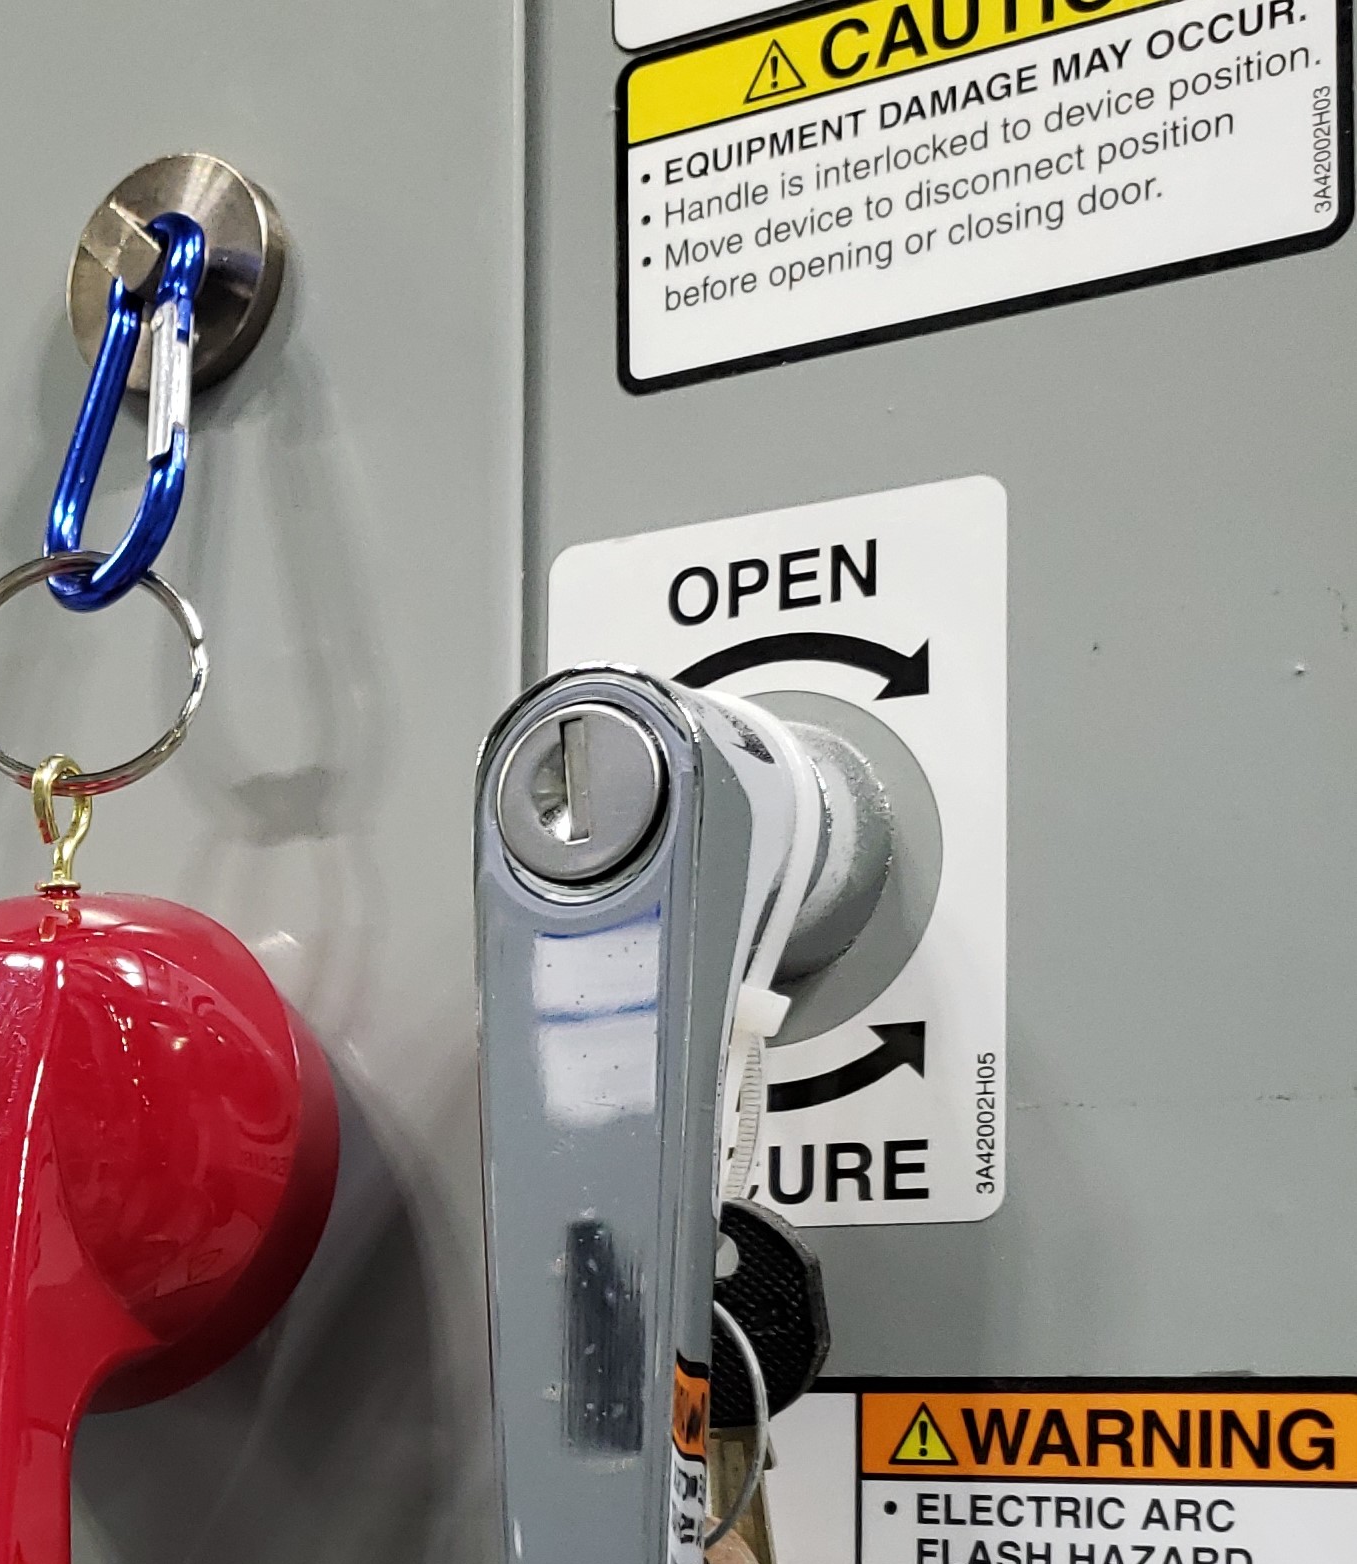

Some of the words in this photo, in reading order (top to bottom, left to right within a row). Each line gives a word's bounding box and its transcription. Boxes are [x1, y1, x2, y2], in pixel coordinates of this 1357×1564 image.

[664, 109, 867, 186] EQUIPMENT
[879, 64, 1038, 131] DAMAGE
[1052, 38, 1133, 86] MAY
[1146, 0, 1307, 60] OCCUR.
[820, 0, 1113, 79] CAUT
[664, 181, 769, 229] Handle
[780, 173, 804, 200] is
[815, 121, 989, 191] interlocked
[1003, 117, 1031, 145] to
[1044, 85, 1155, 134] device
[1169, 46, 1322, 111] position.
[664, 233, 744, 270] Move
[754, 206, 854, 247] device
[866, 194, 893, 222] to
[905, 145, 1086, 212] disconnect
[1097, 112, 1235, 174] position
[1313, 85, 1332, 214] 3A42002H03
[664, 272, 758, 312] before
[768, 240, 893, 291] opening
[905, 229, 937, 256] or
[948, 200, 1065, 246] closing
[1078, 177, 1163, 216] door.
[668, 538, 878, 627] OPEN
[976, 1051, 996, 1194] 3A42002H05
[961, 1408, 1336, 1471] WARNING
[916, 1493, 1126, 1530] ELECTRIC
[1141, 1499, 1236, 1533] ARC
